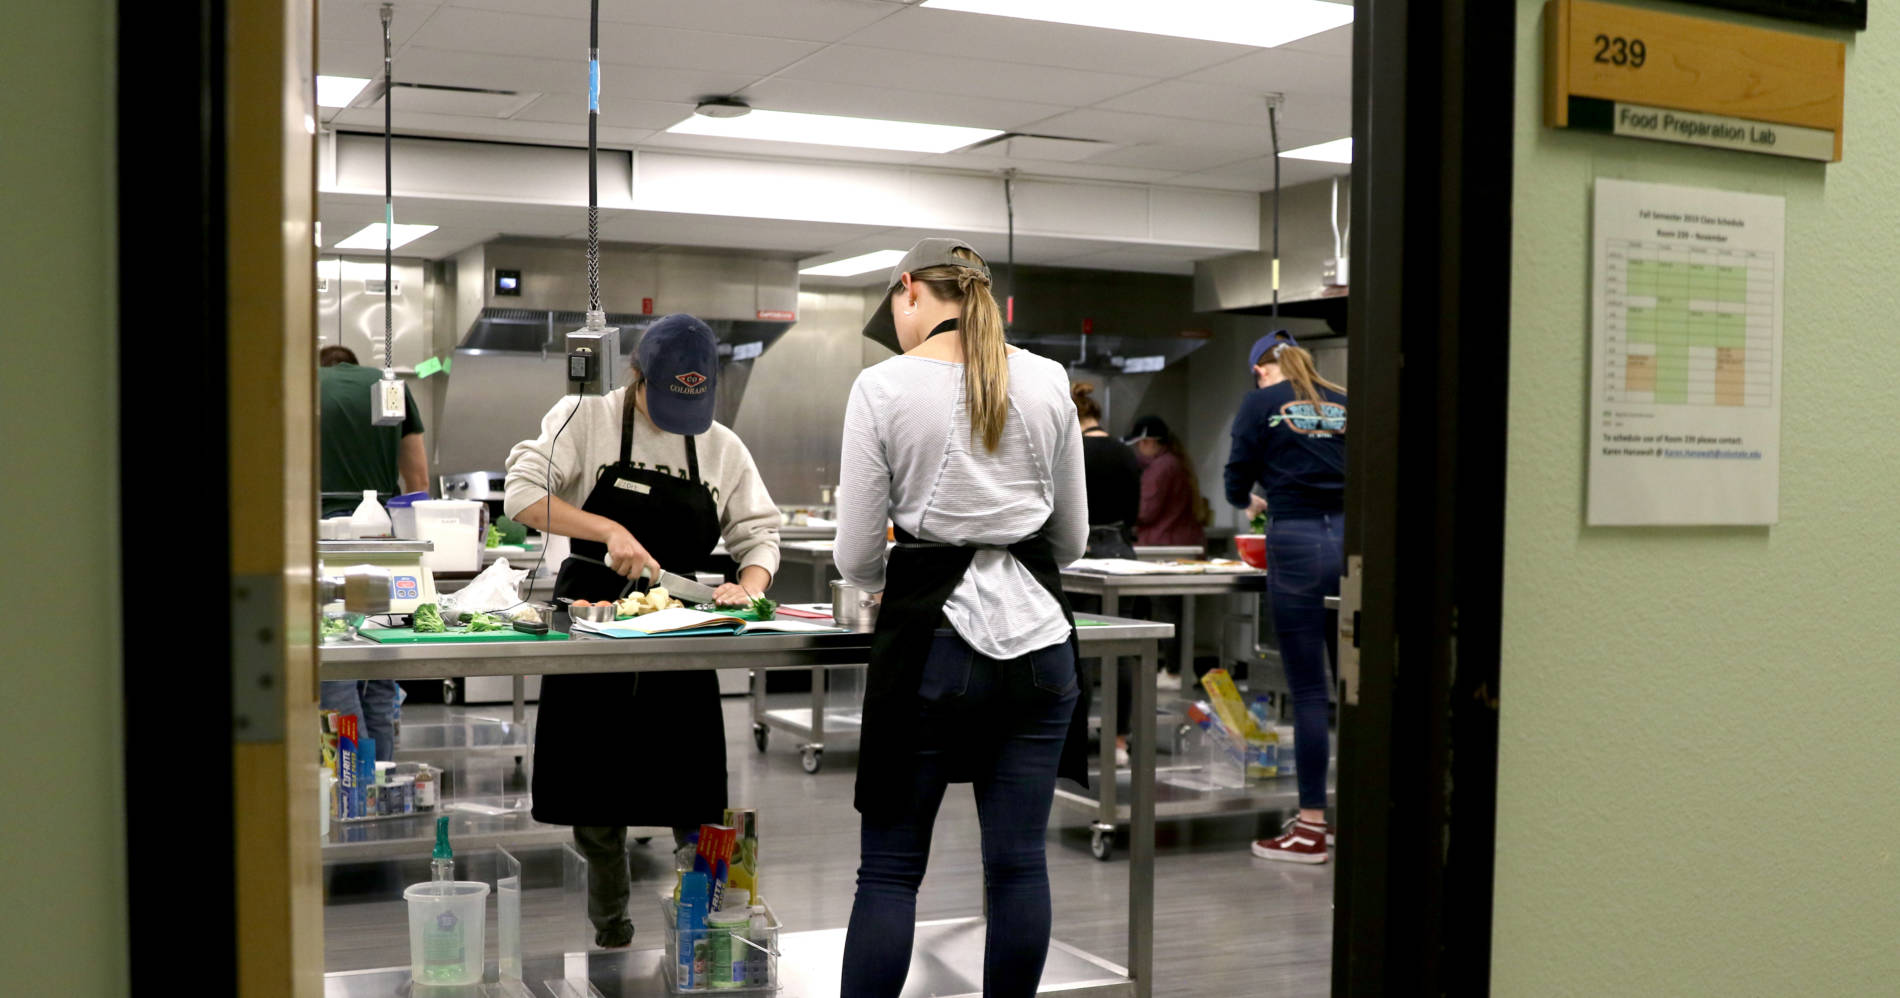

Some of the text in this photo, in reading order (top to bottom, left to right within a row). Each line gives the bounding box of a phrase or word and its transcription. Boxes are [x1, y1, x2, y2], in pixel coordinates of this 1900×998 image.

[1594, 34, 1646, 67] 239
[1620, 109, 1776, 146] Food Preparation Lab
[669, 383, 707, 395] COLORADO
